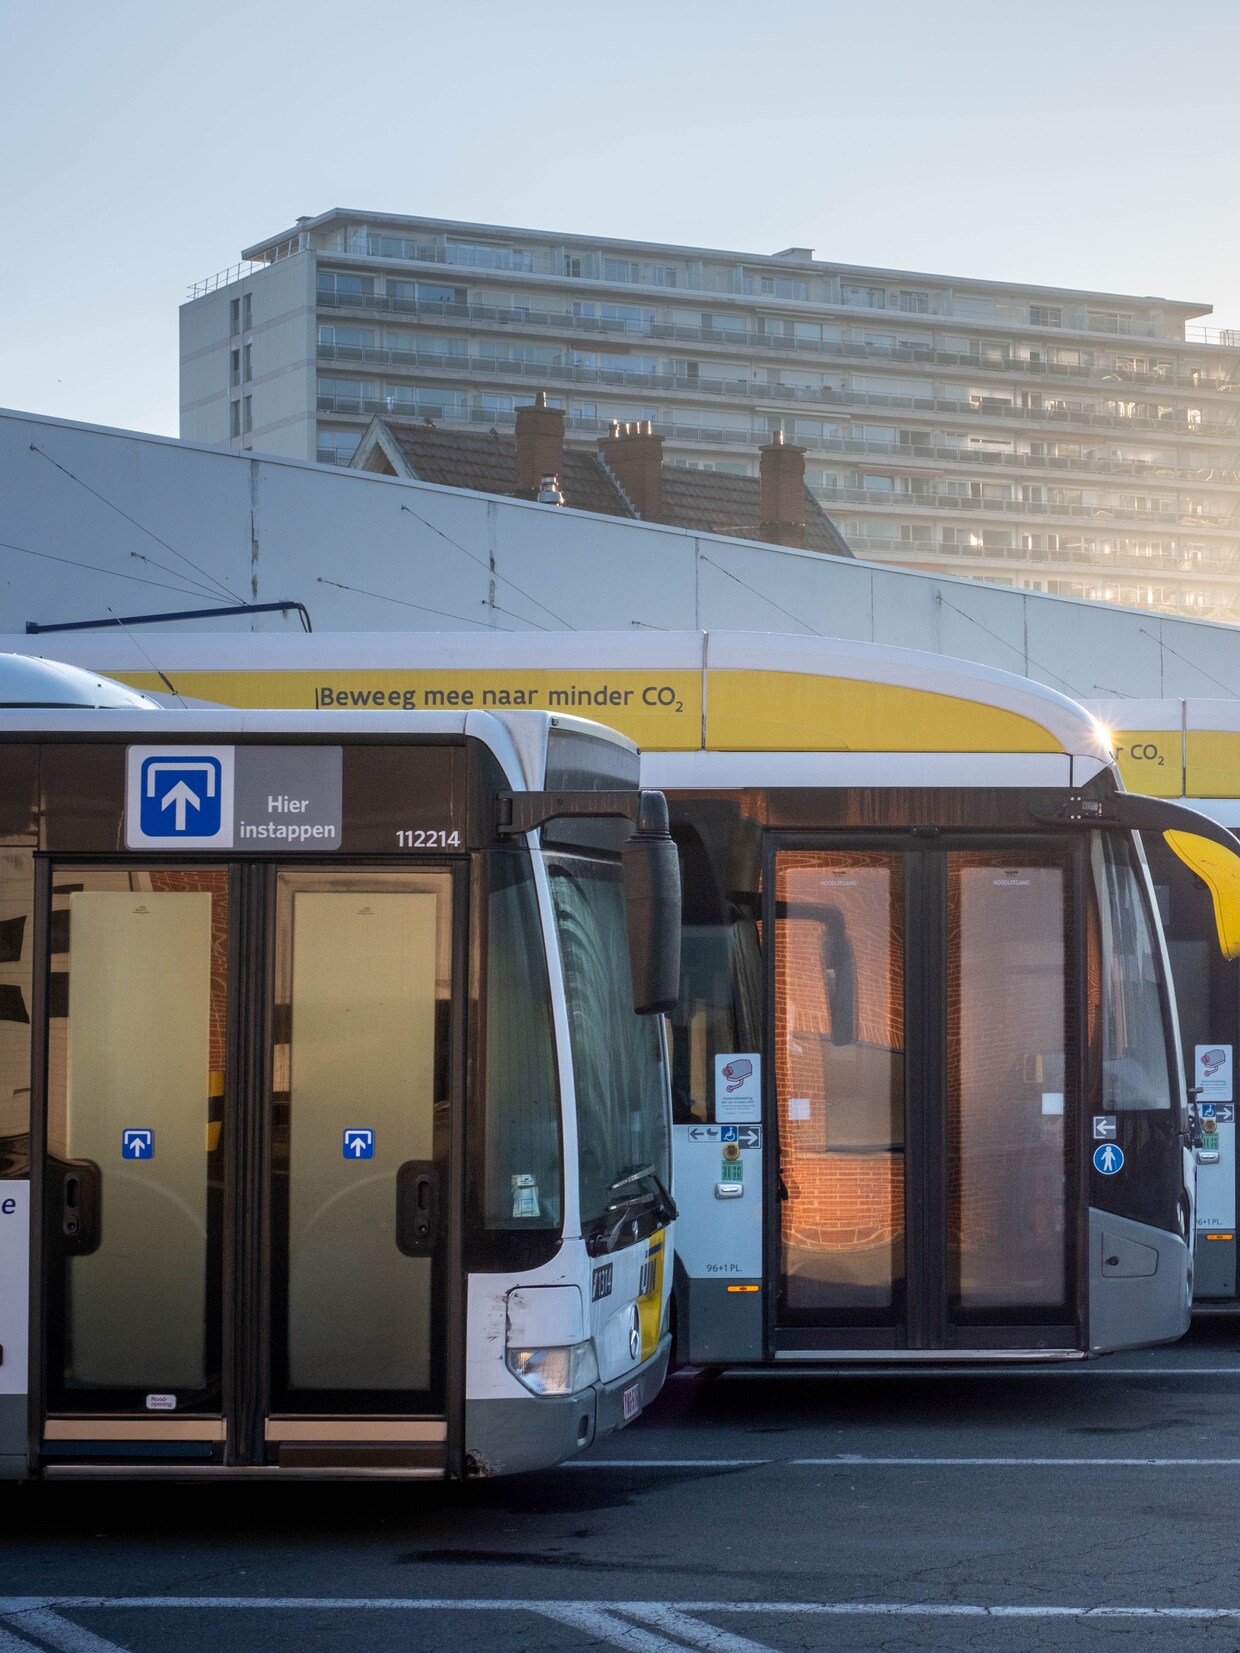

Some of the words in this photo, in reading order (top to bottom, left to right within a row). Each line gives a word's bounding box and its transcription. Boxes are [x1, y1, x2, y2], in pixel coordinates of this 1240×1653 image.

[320, 687, 416, 710] Beweeg
[424, 689, 474, 705] mee
[482, 689, 539, 705] naar
[549, 686, 634, 705] minder
[267, 795, 309, 813] Hier
[240, 821, 336, 842] instappen
[396, 830, 460, 847] 112214
[706, 1264, 728, 1273] 96+1
[730, 1264, 743, 1273] PL.
